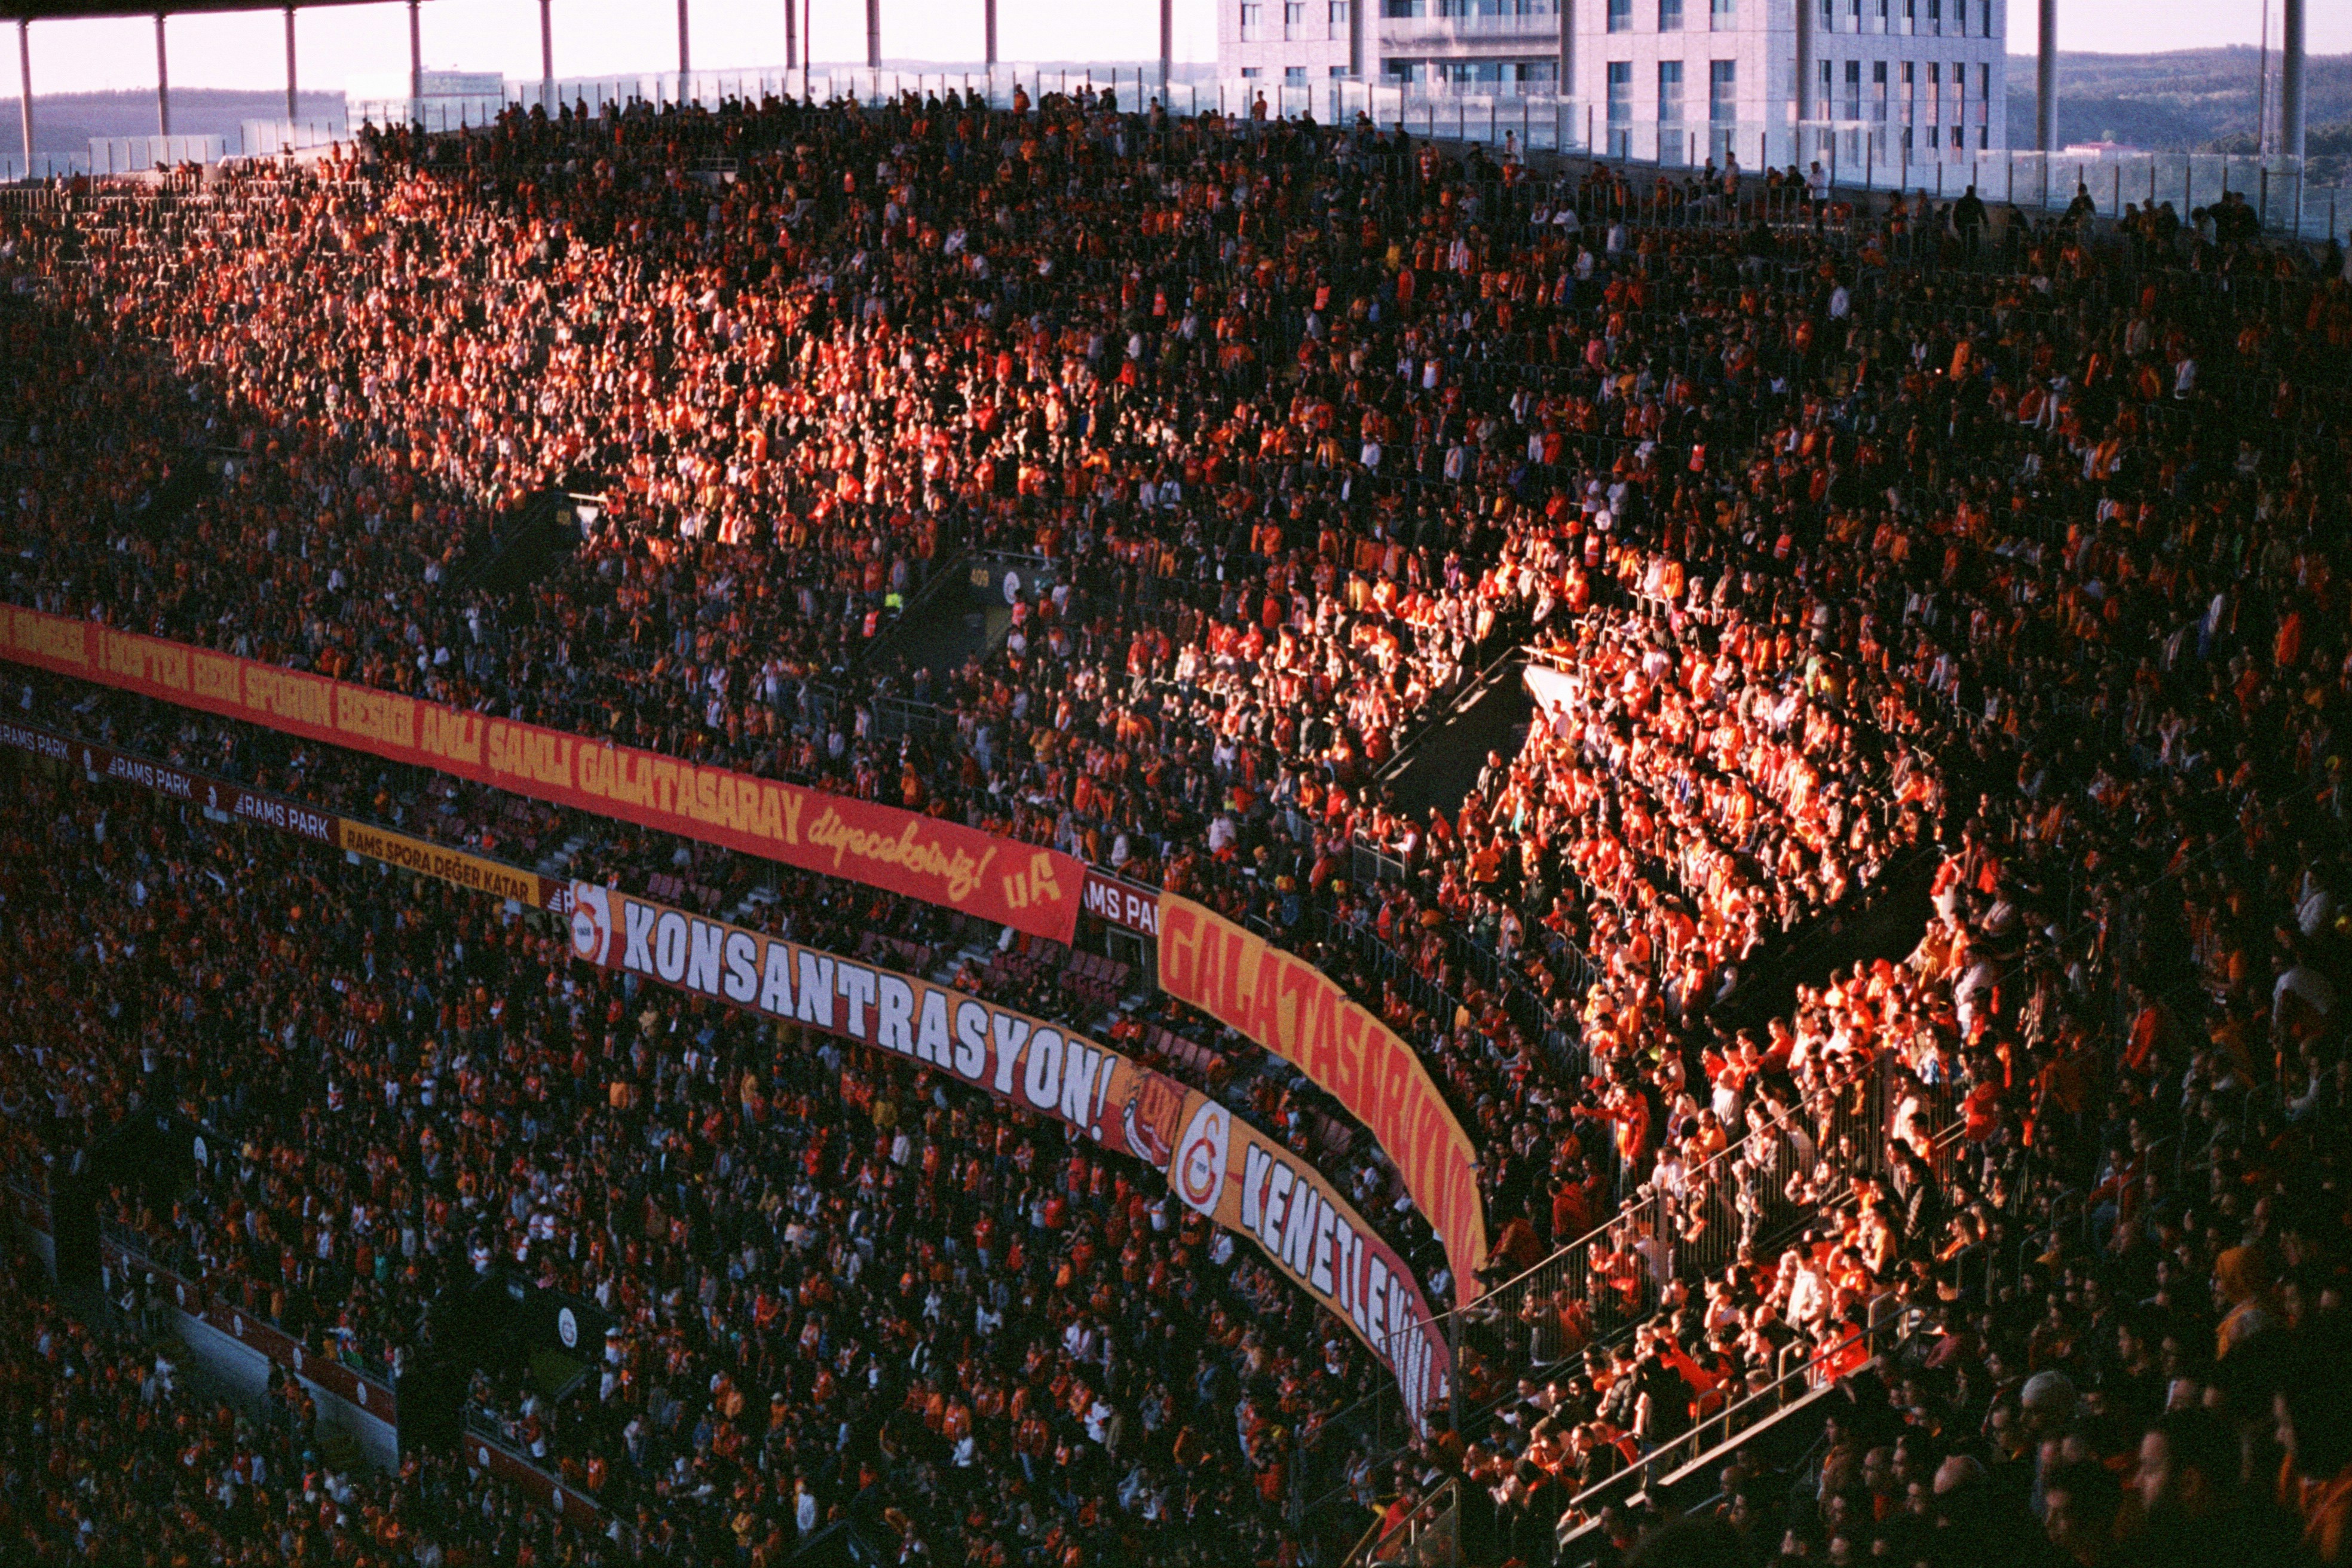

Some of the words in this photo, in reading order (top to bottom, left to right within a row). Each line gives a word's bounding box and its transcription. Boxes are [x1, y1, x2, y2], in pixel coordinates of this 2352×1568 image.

[3, 725, 35, 753] RAMS
[37, 734, 70, 761] PARK
[246, 664, 333, 728] SPORUN
[578, 743, 803, 844] GALATASARAY
[117, 759, 154, 788] RAMS
[156, 768, 192, 798] PARK
[243, 796, 285, 828] RAMS
[288, 807, 330, 841] PARK
[347, 829, 384, 858] RAMS
[386, 841, 431, 871] SPORA
[434, 855, 480, 887] DEĞER
[484, 871, 529, 902] KATAR
[623, 898, 1119, 1141] KONSANTRASYON!
